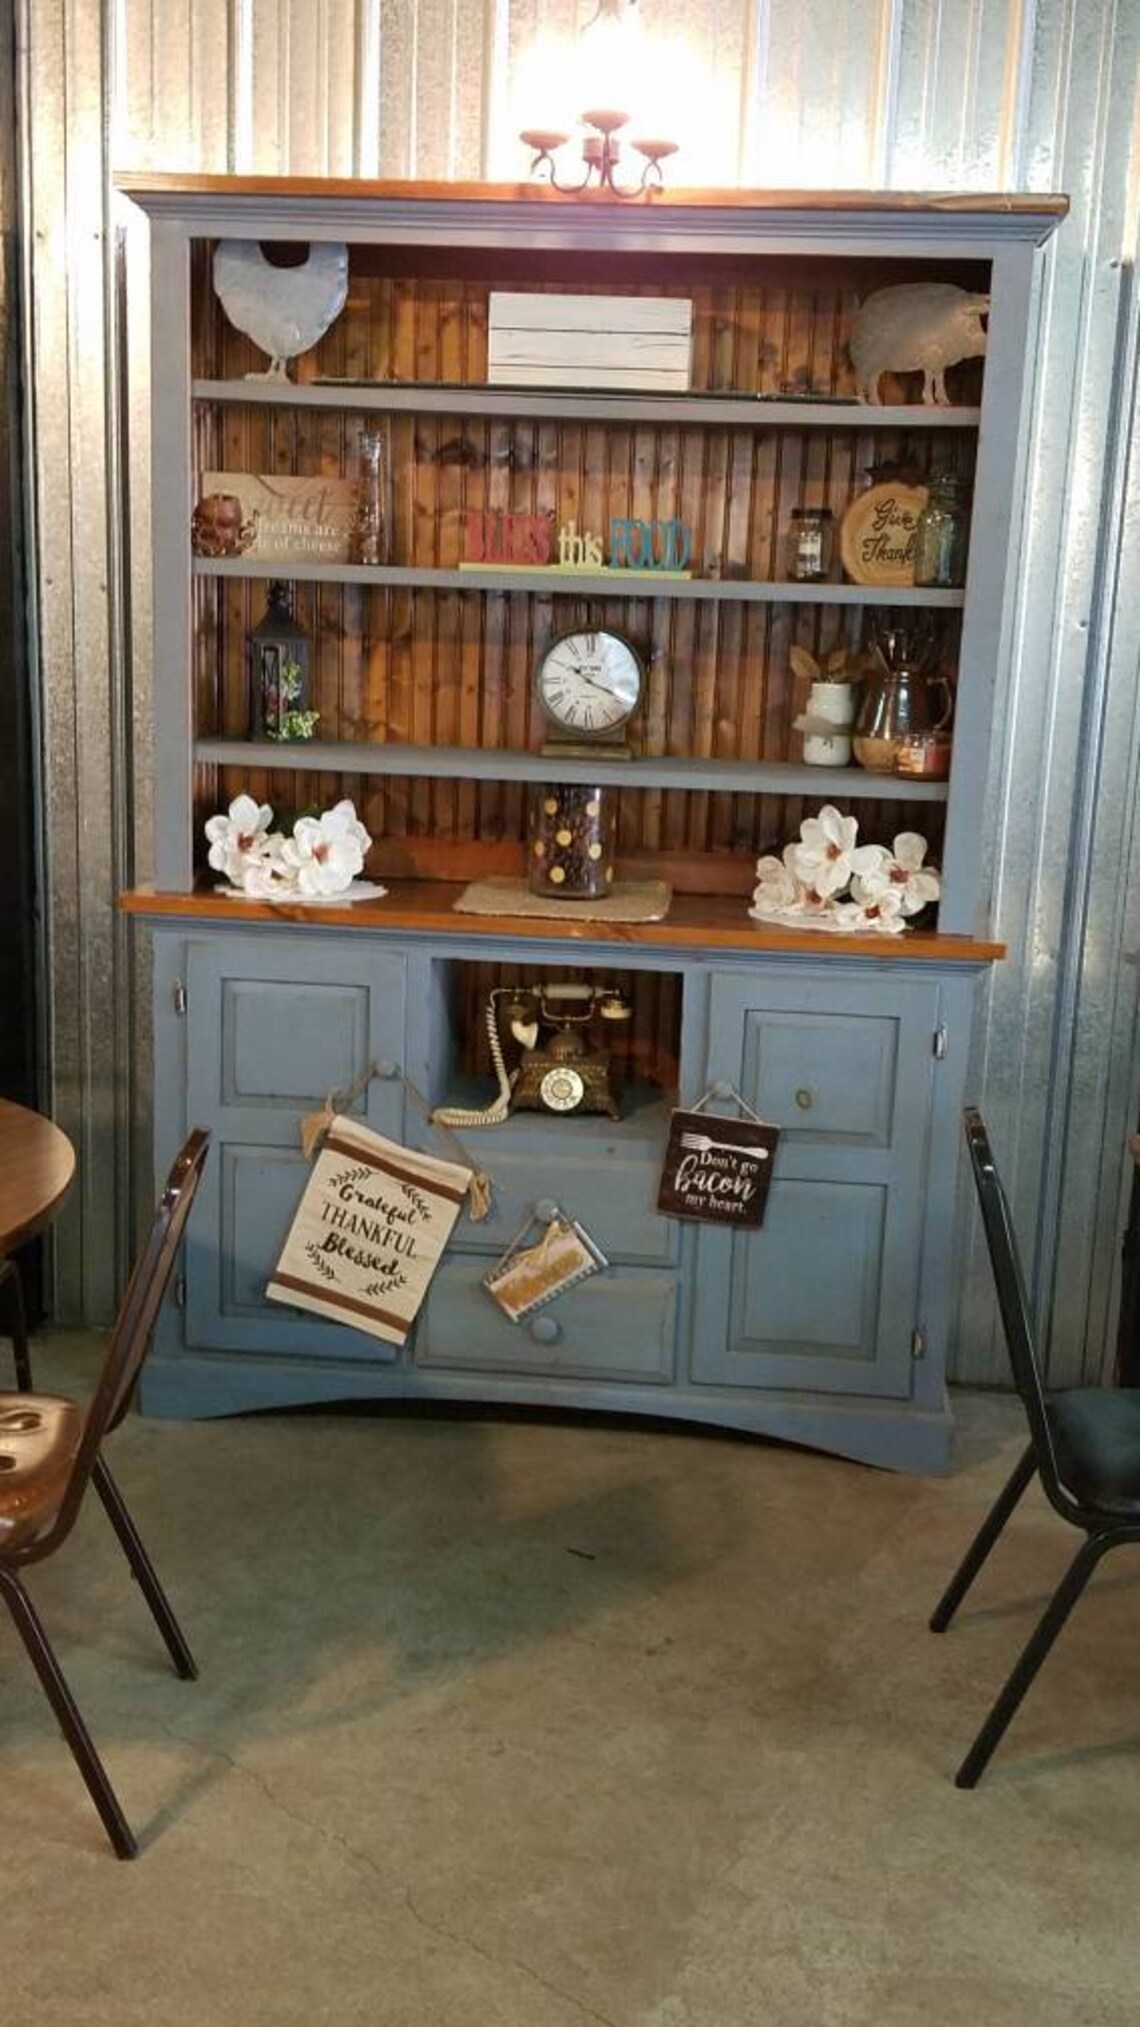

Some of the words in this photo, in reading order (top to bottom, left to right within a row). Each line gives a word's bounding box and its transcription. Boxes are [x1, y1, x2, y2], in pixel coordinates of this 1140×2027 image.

[872, 498, 918, 531] Give
[557, 520, 604, 566] this
[610, 518, 693, 571] FOOD
[674, 1154, 757, 1201] bacon
[700, 1151, 738, 1170] Don't
[740, 1162, 759, 1177] go
[339, 1183, 417, 1225] Grateful
[685, 1193, 707, 1209] my
[321, 1200, 417, 1259] THANKFUL
[319, 1232, 401, 1276] Blessed
